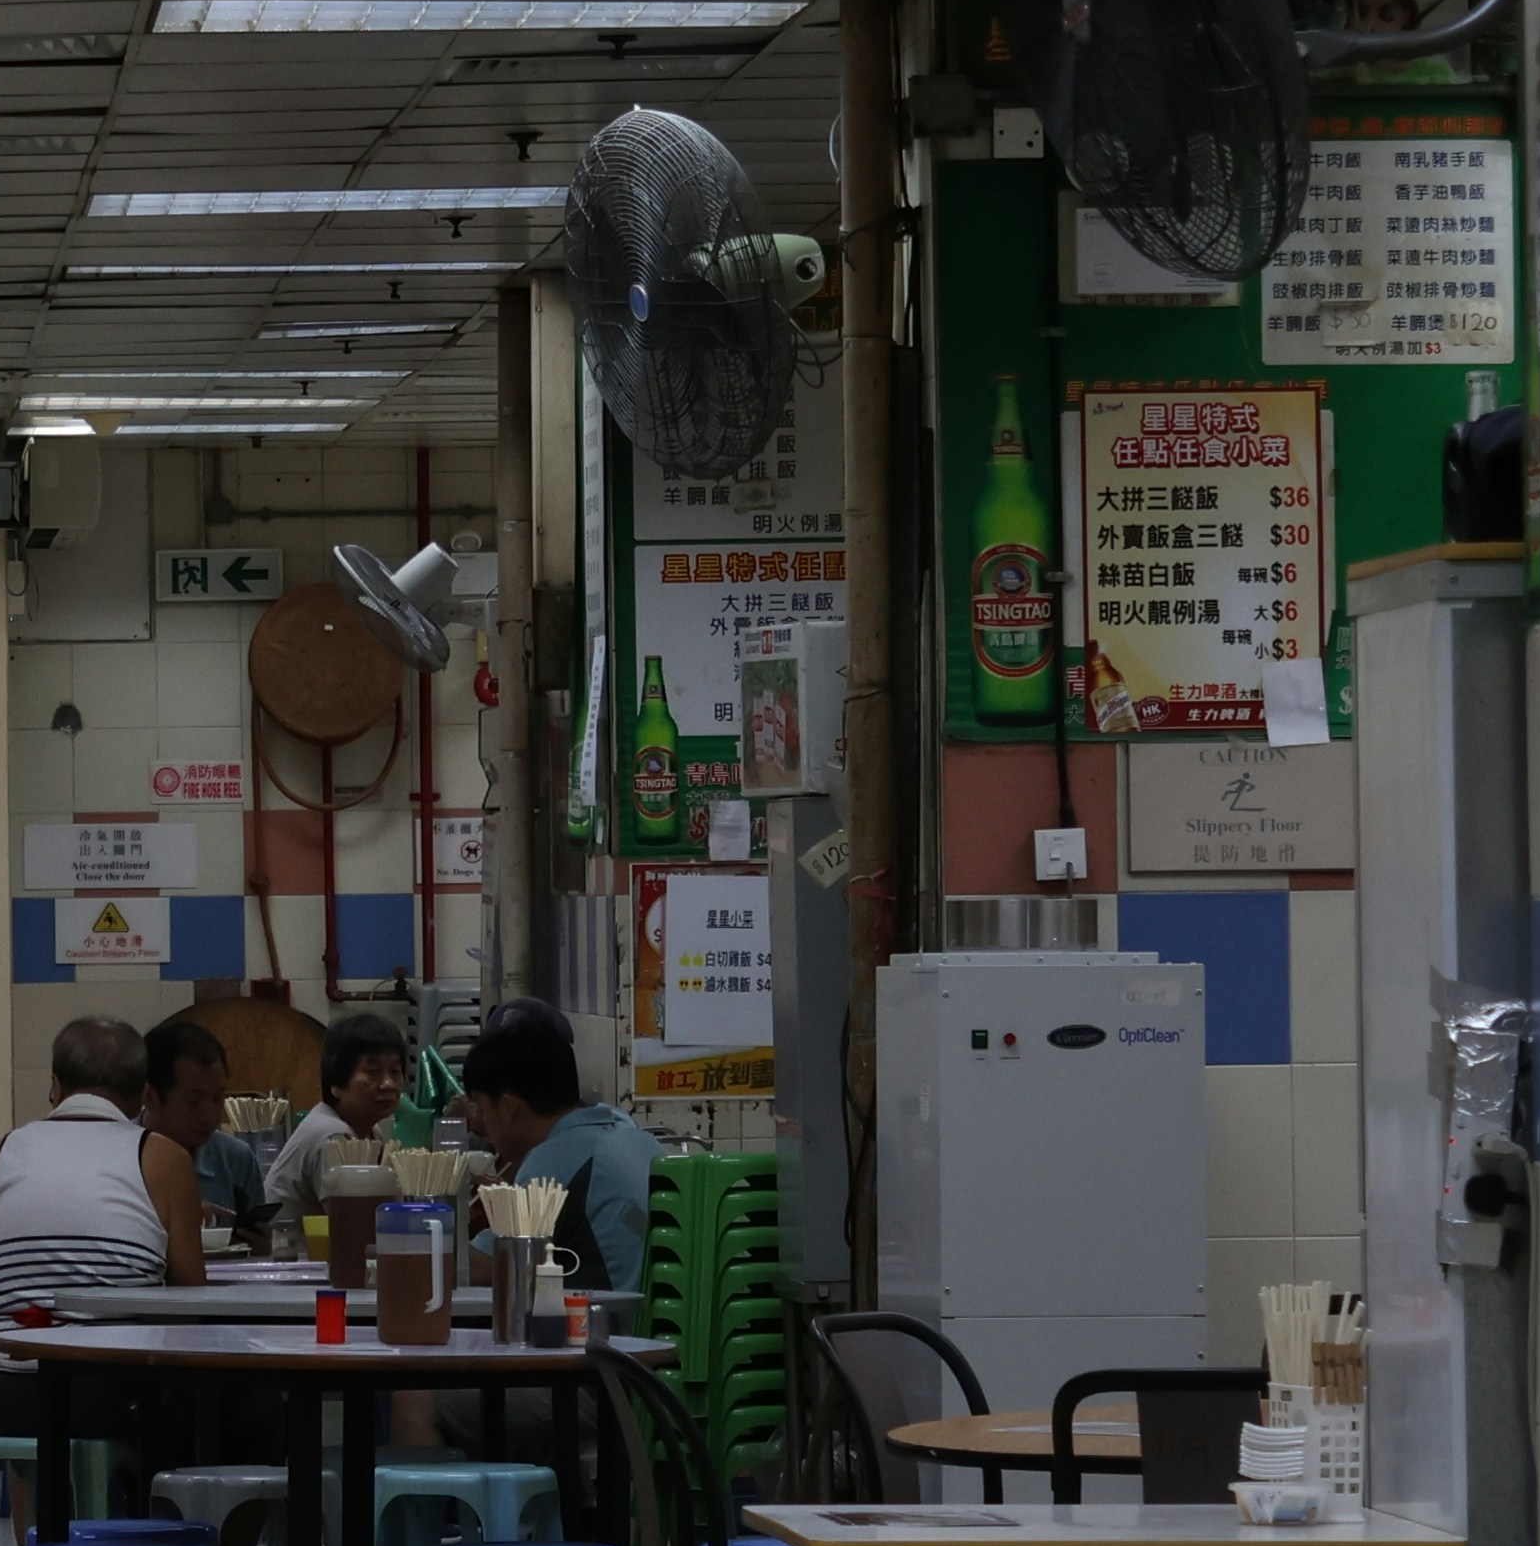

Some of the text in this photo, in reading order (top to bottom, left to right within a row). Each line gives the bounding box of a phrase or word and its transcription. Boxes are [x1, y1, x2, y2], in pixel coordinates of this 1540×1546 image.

[1394, 151, 1485, 168] 南乳豬手飯
[1394, 184, 1486, 201] 香芋油鴨飯
[1140, 402, 1261, 435] 星星特式
[1112, 436, 1291, 467] 任點任食小菜
[1270, 486, 1310, 511] $36
[1270, 524, 1311, 549] $30
[1097, 562, 1196, 588] 絲苗白飯
[1271, 562, 1297, 586] $6
[976, 602, 1052, 621] TSINGTAO
[1272, 600, 1298, 623] $6
[1272, 639, 1298, 661] $3
[1169, 683, 1237, 700] 生力啤酒
[1142, 703, 1161, 717] HK
[1185, 707, 1251, 722] 生力啤酒
[183, 782, 243, 798] FIRE HOSE REEL
[635, 777, 677, 789] TSINGTAO
[1186, 818, 1302, 836] Slippery Floor
[1194, 844, 1296, 863] 提防地滑
[105, 873, 121, 882] the
[123, 873, 146, 882] door
[452, 868, 474, 878] Dogs
[706, 909, 754, 928] 星星小菜
[83, 934, 144, 947] 小心地滑
[705, 950, 752, 968] 白切雞飯
